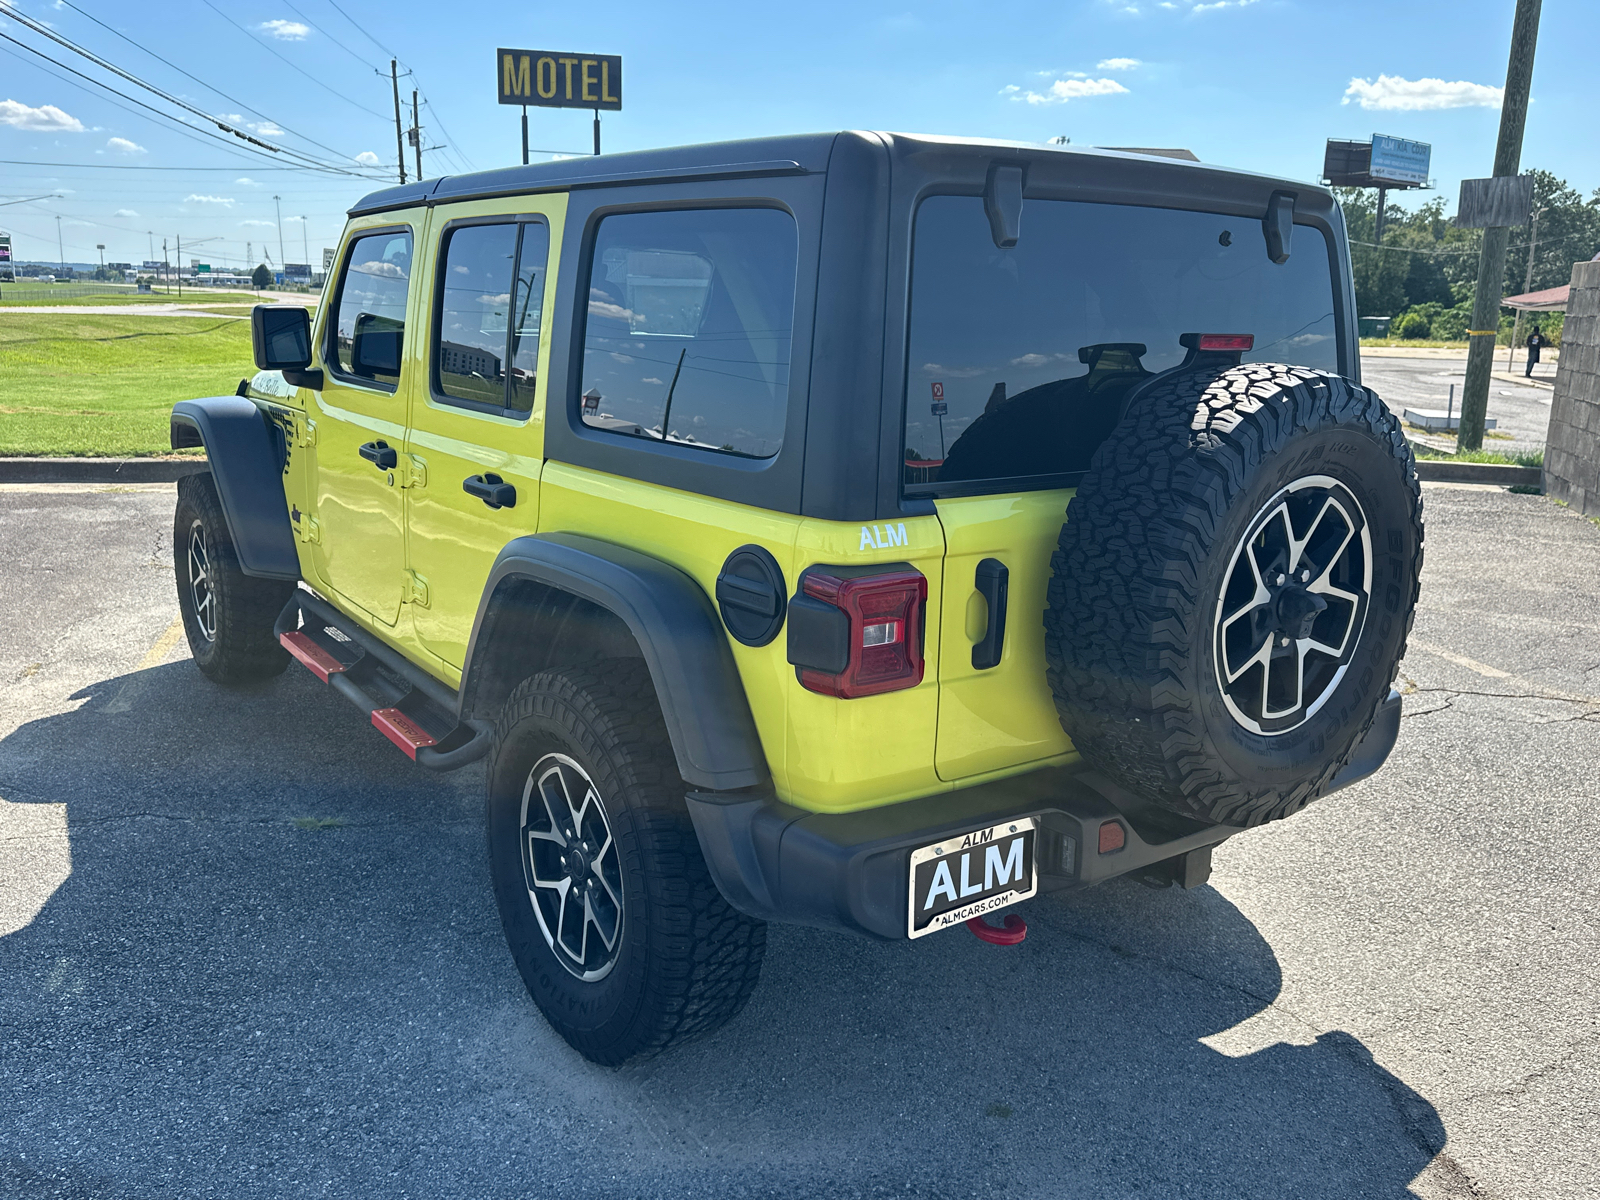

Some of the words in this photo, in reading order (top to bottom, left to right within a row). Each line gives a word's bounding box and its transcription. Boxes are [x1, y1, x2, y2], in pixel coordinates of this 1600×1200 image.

[503, 54, 619, 102] MOTEL
[1380, 138, 1395, 150] ALM
[859, 522, 909, 551] ALM
[960, 827, 994, 850] ALM
[923, 836, 1025, 911] ALM
[940, 894, 1009, 926] ALMCARS.COM
